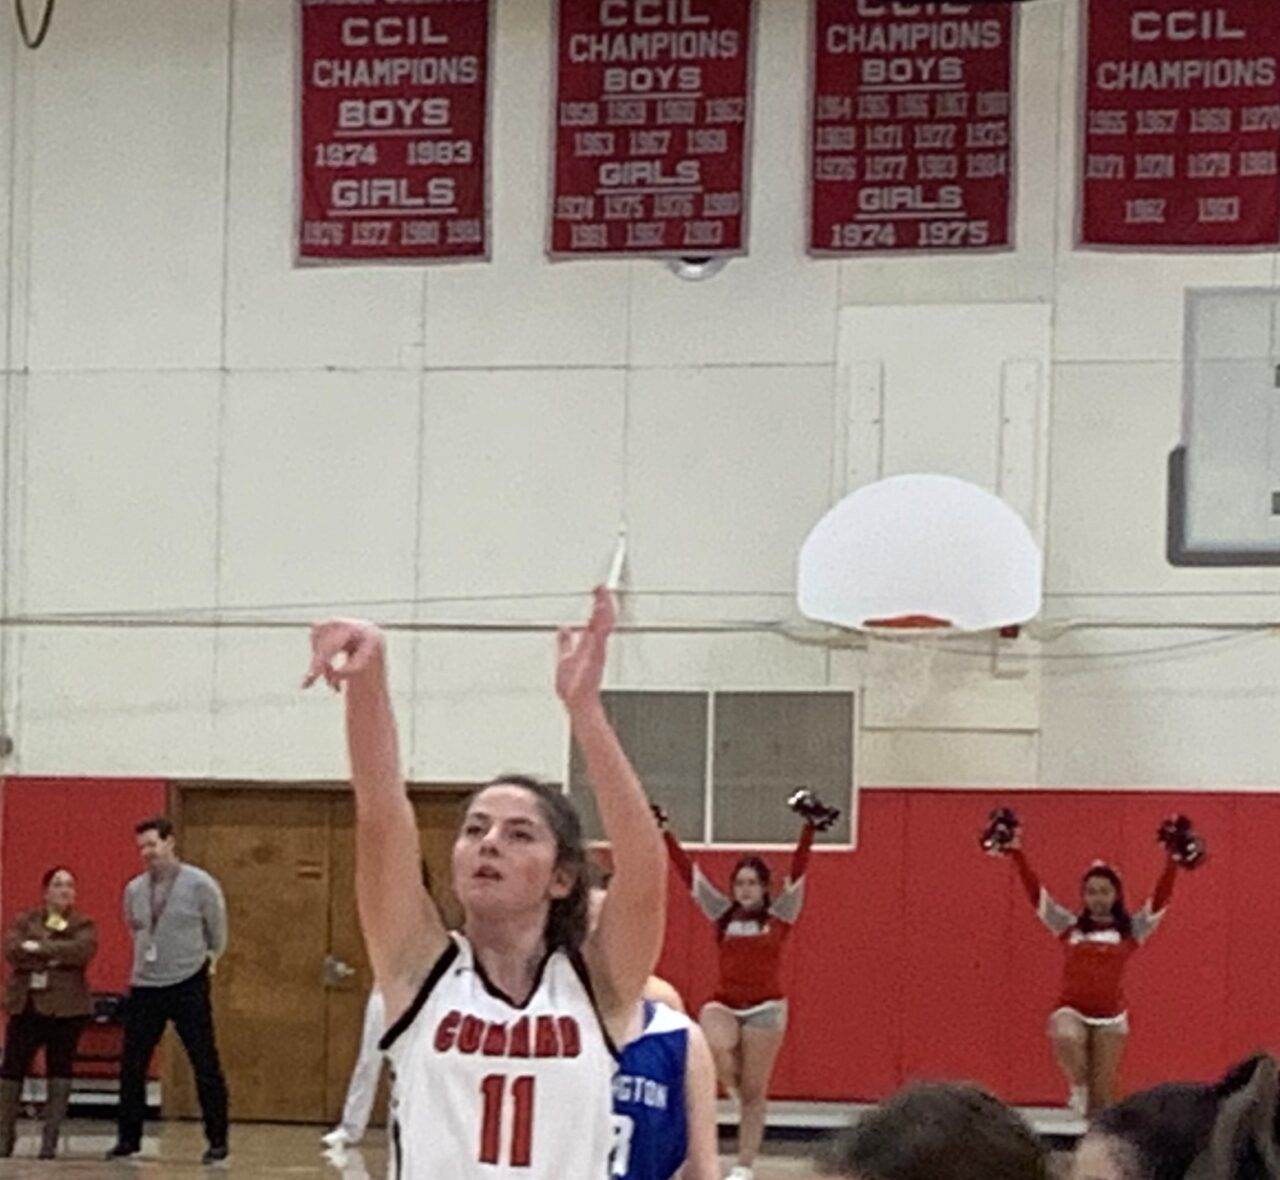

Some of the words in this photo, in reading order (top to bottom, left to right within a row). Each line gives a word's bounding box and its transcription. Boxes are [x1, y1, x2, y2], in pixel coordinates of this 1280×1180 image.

[601, 0, 709, 26] CCIL
[1131, 10, 1246, 40] CCIL
[342, 17, 448, 46] CCIL
[569, 30, 737, 62] CHAMPIONS
[827, 20, 1001, 53] CHAMPIONS
[313, 56, 478, 88] CHAMPIONS
[604, 66, 701, 91] BOYS
[863, 57, 962, 83] BOYS
[1097, 57, 1276, 90] CHAMPIONS
[338, 98, 450, 129] BOYS
[406, 141, 472, 165] 1983
[599, 160, 700, 186] GIRLS
[331, 177, 455, 208] GIRLS
[859, 185, 962, 211] GIRLS
[830, 223, 896, 247] 1974
[917, 221, 988, 246] 1975
[478, 1073, 535, 1167] 11
